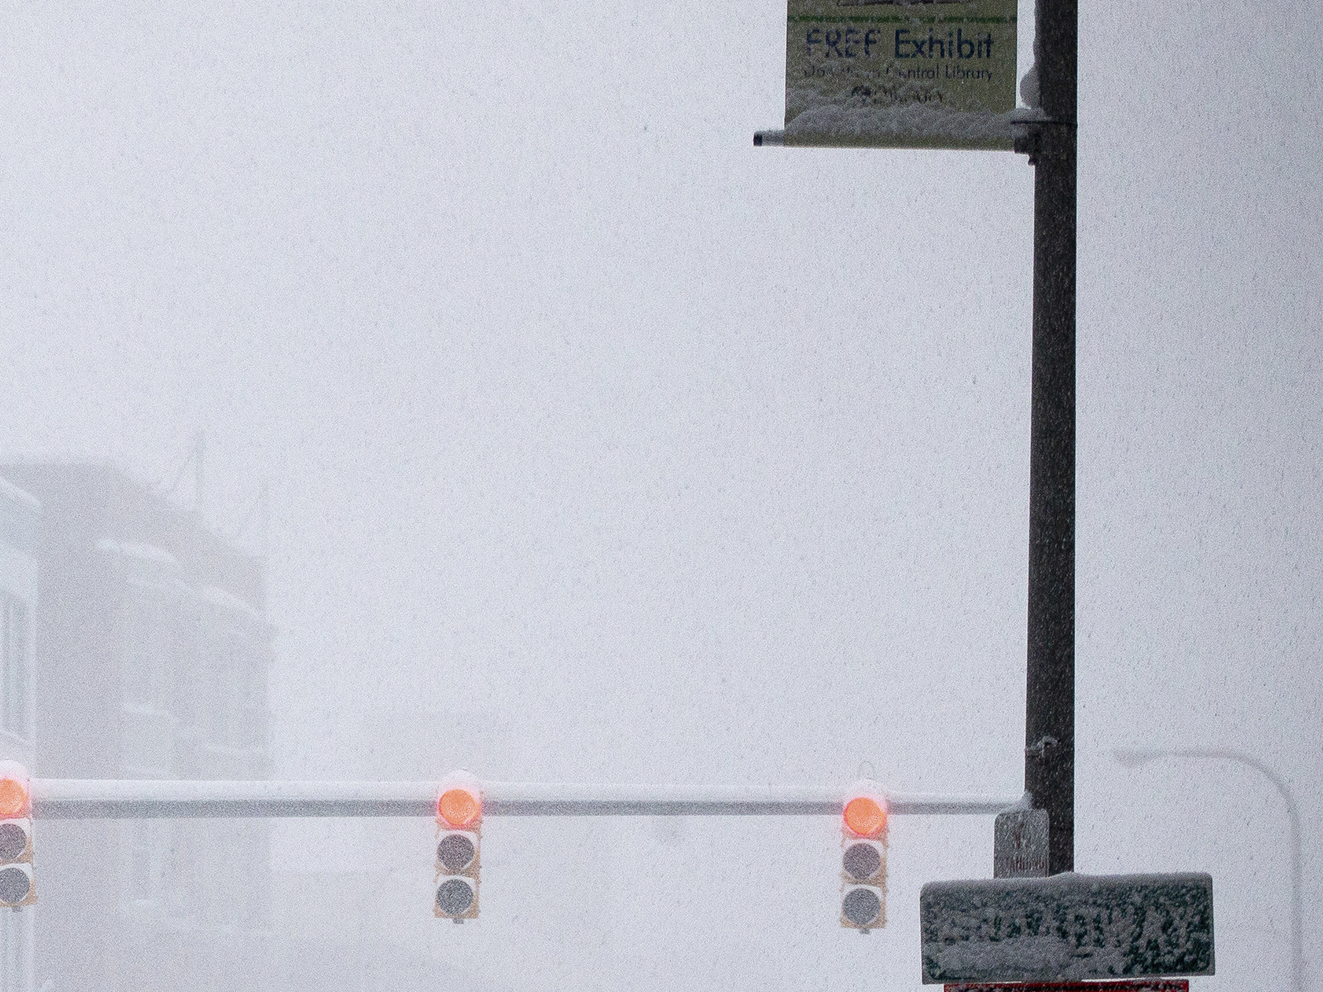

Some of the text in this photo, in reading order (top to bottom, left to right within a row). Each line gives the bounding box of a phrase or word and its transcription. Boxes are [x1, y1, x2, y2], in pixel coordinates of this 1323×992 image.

[893, 27, 995, 60] Exhibit
[885, 63, 940, 80] ntral
[945, 64, 993, 82] Library
